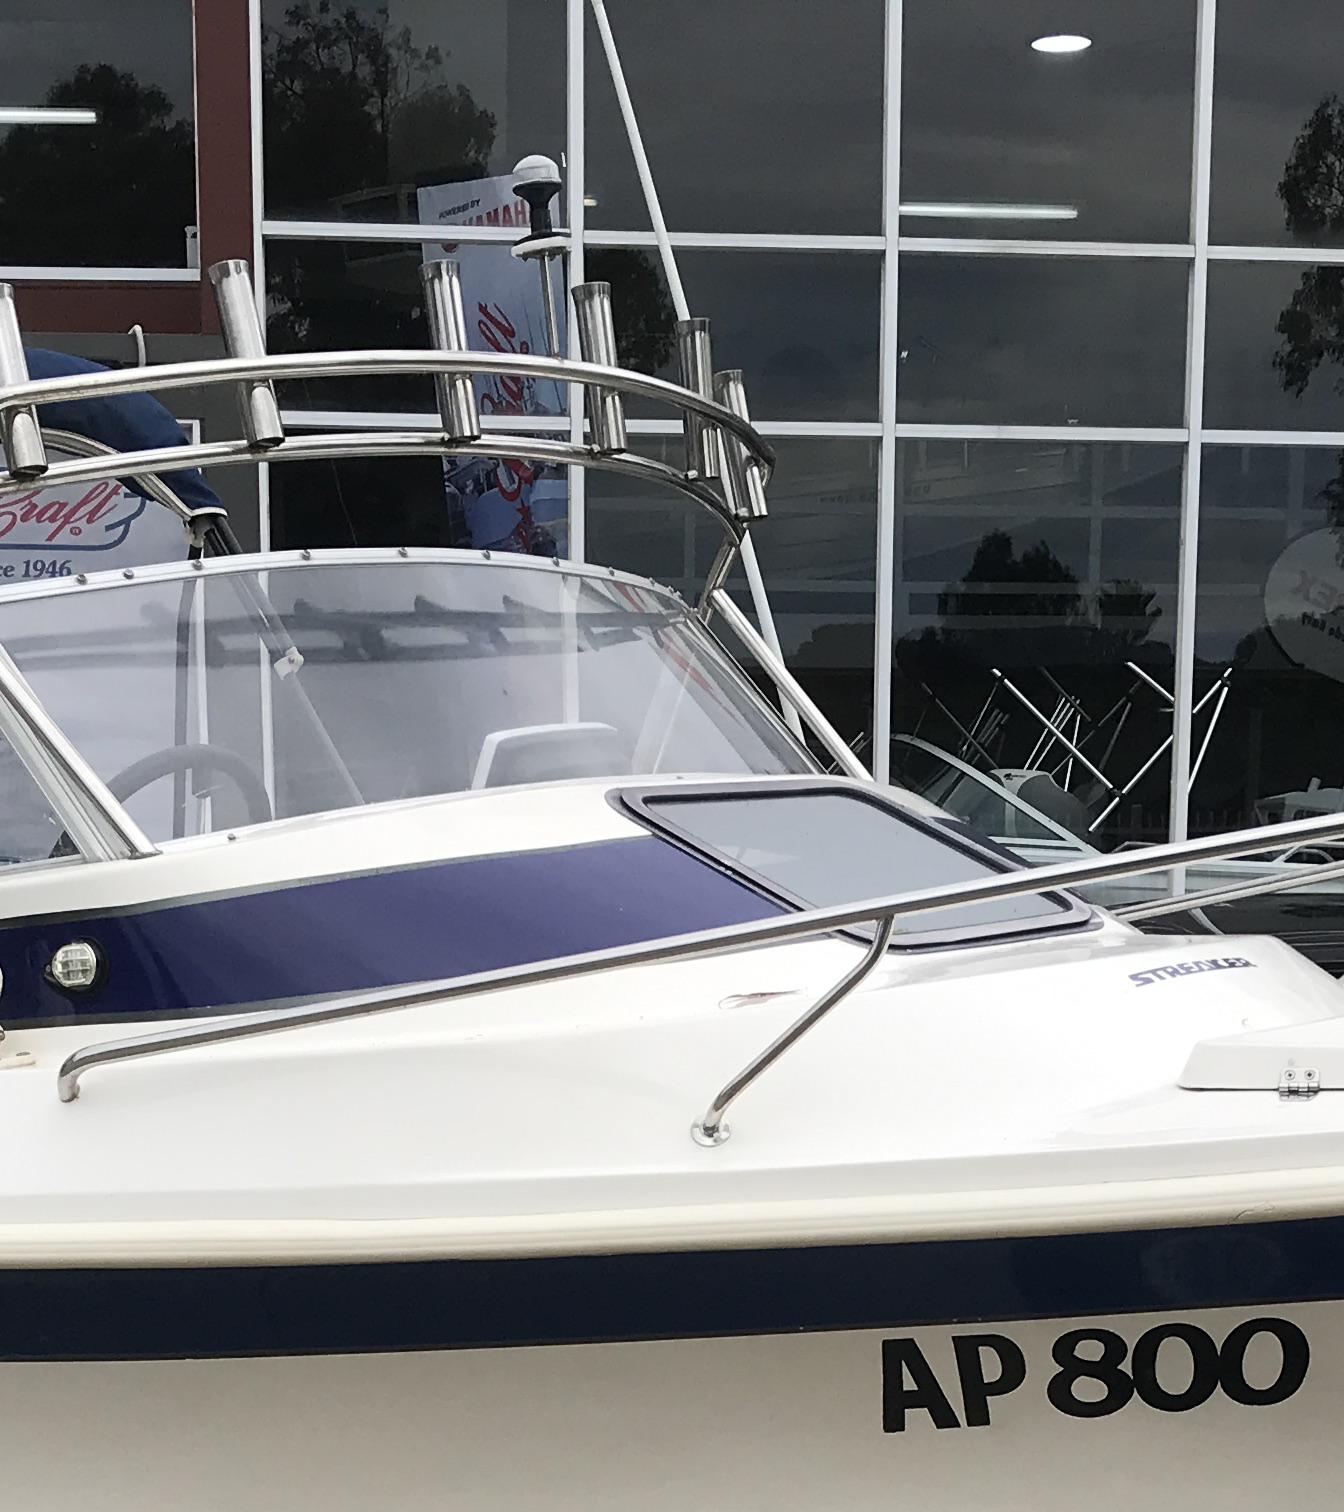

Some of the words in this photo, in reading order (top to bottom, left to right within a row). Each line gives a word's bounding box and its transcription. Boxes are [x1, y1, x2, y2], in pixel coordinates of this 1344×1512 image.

[470, 198, 481, 208] BY
[21, 559, 72, 578] 1946
[882, 1333, 1026, 1433] AP
[1047, 1317, 1311, 1419] 800
